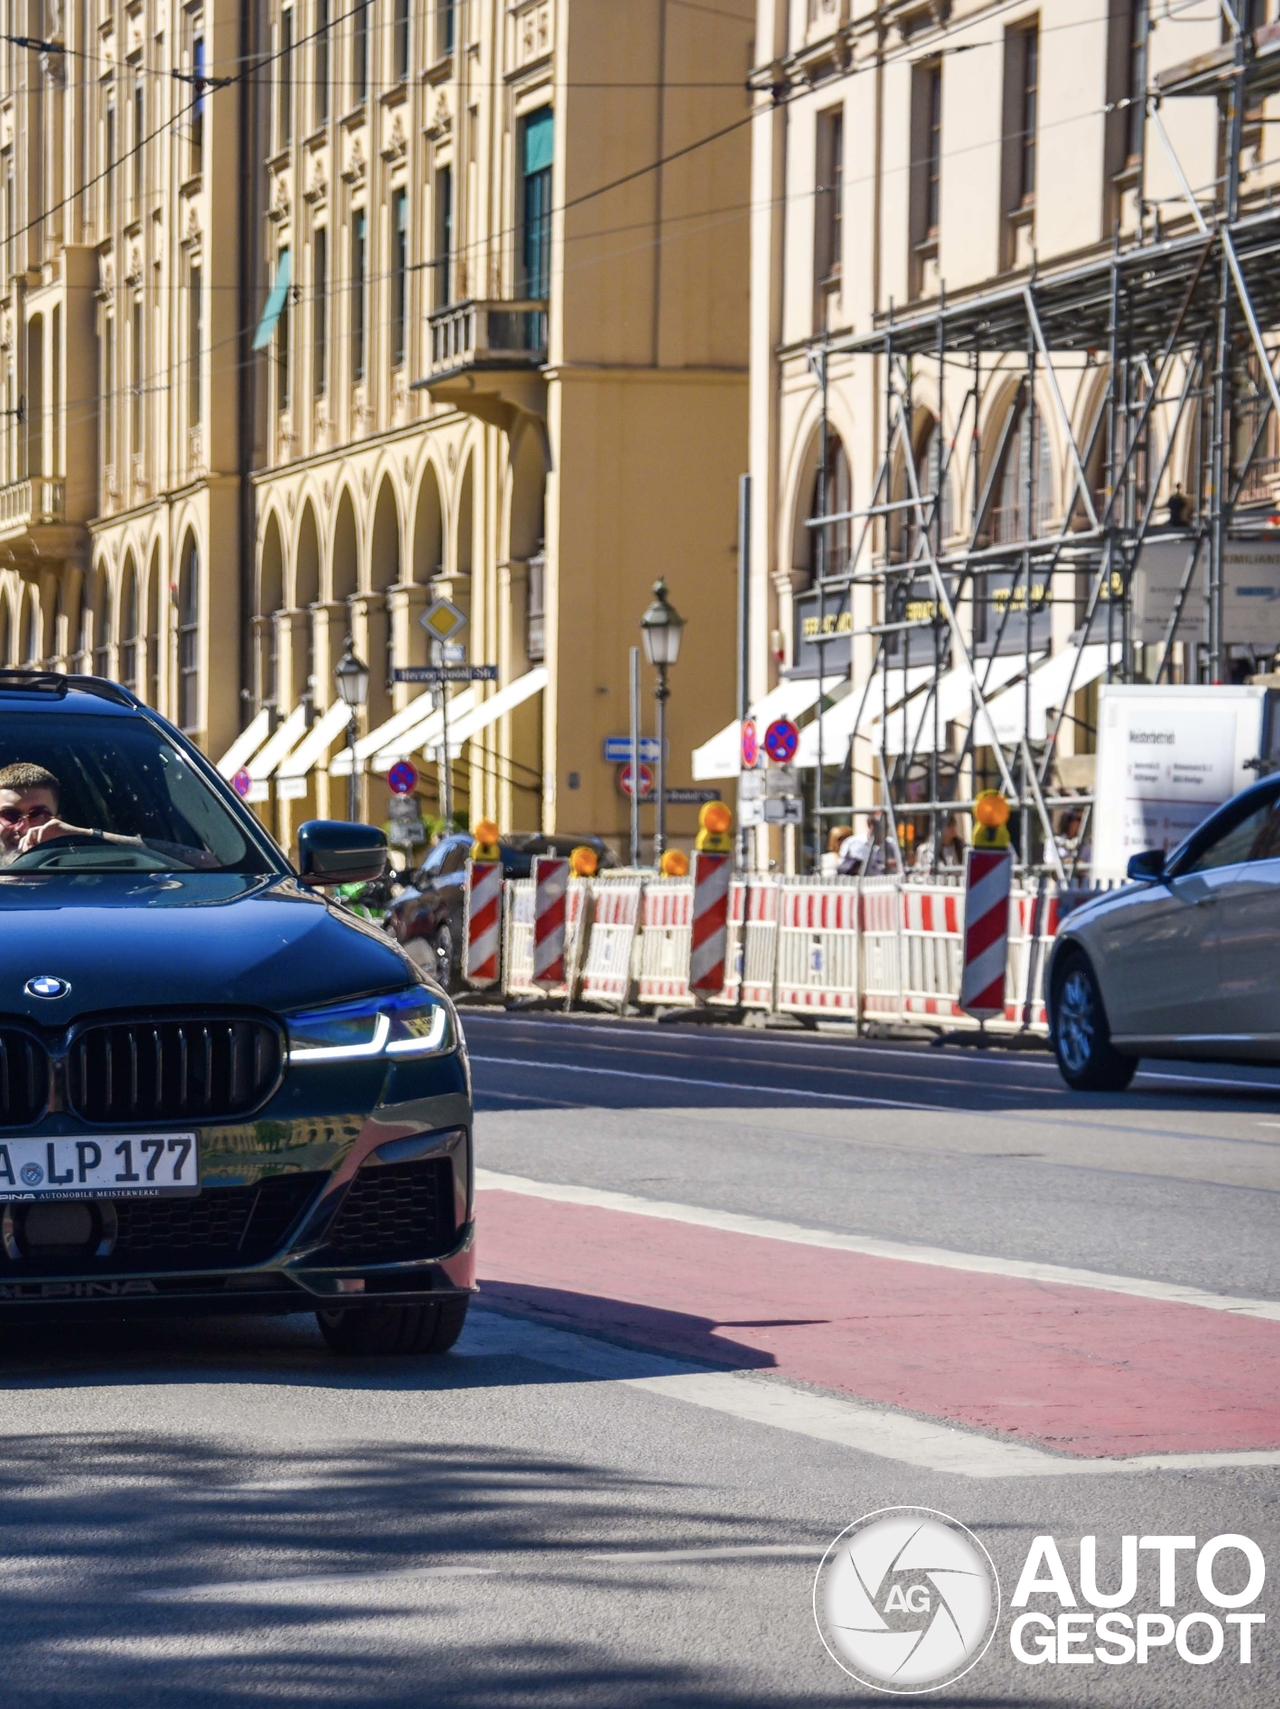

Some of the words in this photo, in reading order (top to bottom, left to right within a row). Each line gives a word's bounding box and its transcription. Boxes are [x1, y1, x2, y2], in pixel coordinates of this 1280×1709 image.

[47, 1141, 102, 1184] LP
[115, 1139, 192, 1182] 177
[39, 1190, 94, 1200] AUTOMOBILE
[96, 1188, 160, 1198] MEISTERWERKE
